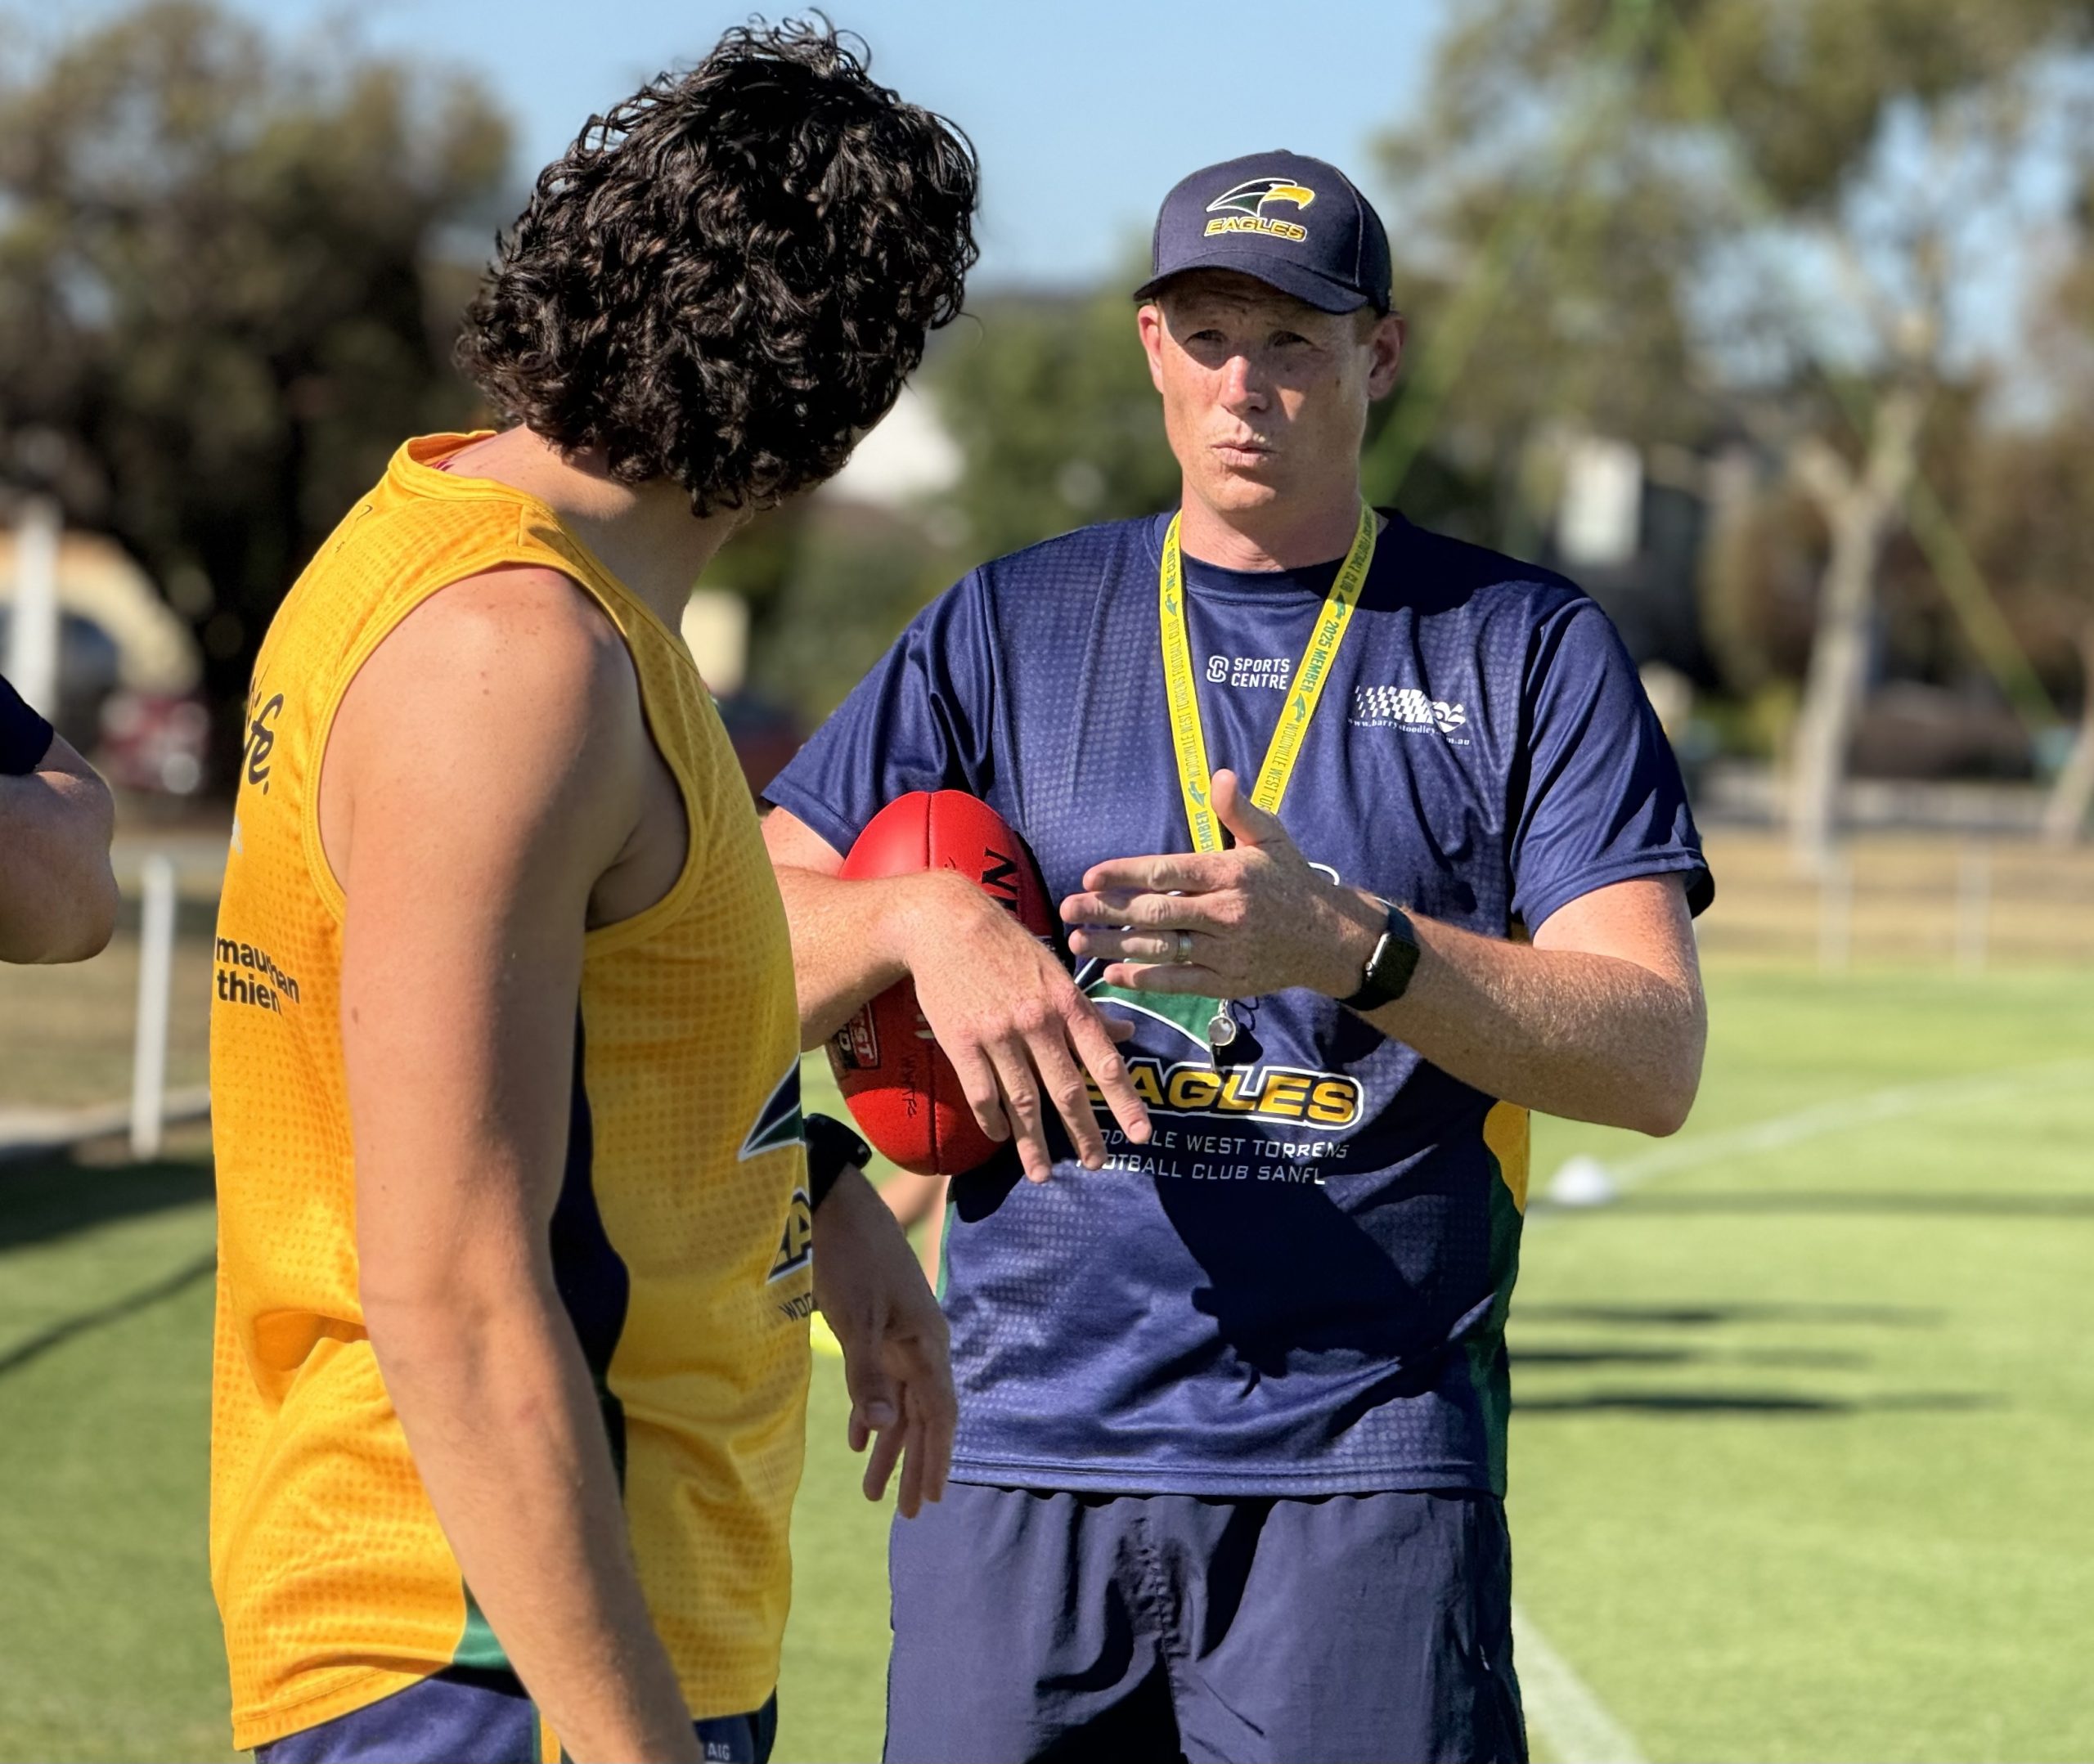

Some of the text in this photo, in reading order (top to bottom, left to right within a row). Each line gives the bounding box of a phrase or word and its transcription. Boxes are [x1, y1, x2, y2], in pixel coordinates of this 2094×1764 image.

[1205, 218, 1306, 241] EAGLES
[1233, 658, 1290, 673] SPORTS
[1300, 619, 1339, 693] 2025 MEMBER
[1231, 673, 1288, 689] CENTRE
[1168, 618, 1201, 779] WOODVILLE WEST TORRENS FOOTBALL CLUB
[1272, 722, 1301, 768] WOODVILLE
[1264, 768, 1283, 793] WEST
[1186, 1134, 1246, 1155] WEST
[1252, 1139, 1350, 1159] TORRENS
[1076, 1154, 1326, 1185] OTBALL CLUB SANFL
